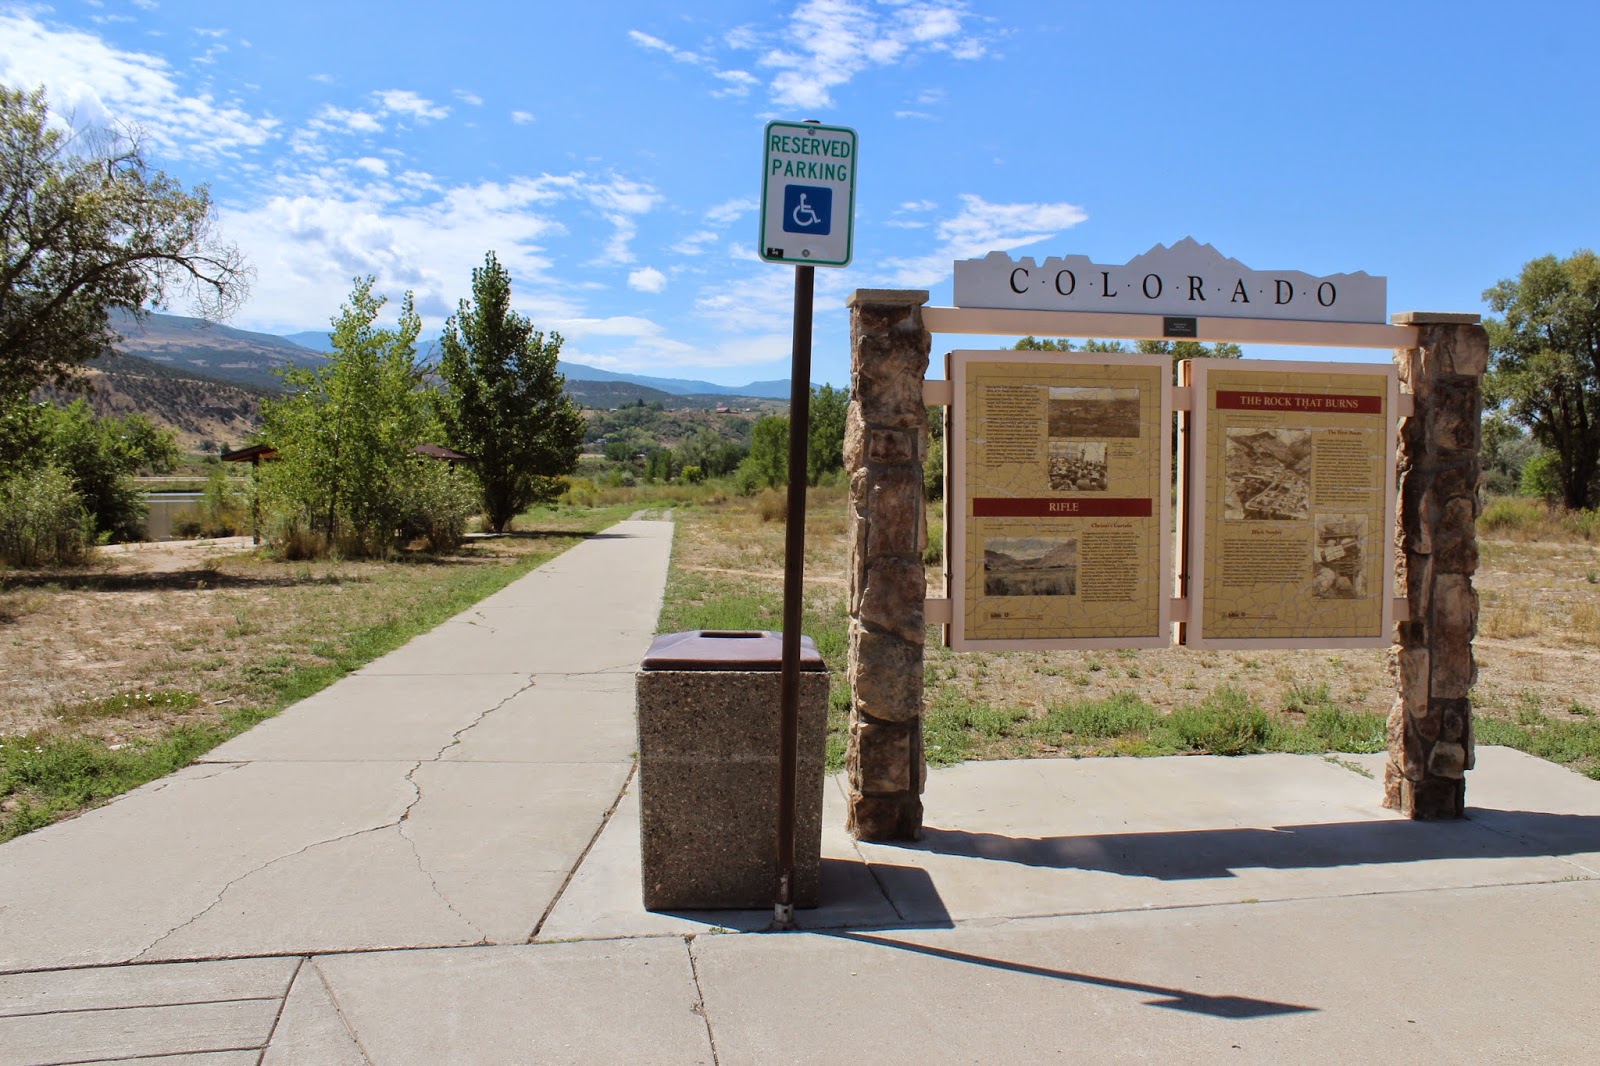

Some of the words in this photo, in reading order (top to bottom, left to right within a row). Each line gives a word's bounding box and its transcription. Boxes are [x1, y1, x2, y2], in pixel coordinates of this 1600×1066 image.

[771, 135, 851, 158] RESERVED
[772, 159, 847, 182] PARKING
[1240, 395, 1262, 405] THE
[1264, 396, 1292, 406] ROCK
[1294, 397, 1322, 407] THAT
[1325, 398, 1359, 409] BURNS
[1049, 502, 1079, 512] RIFLE
